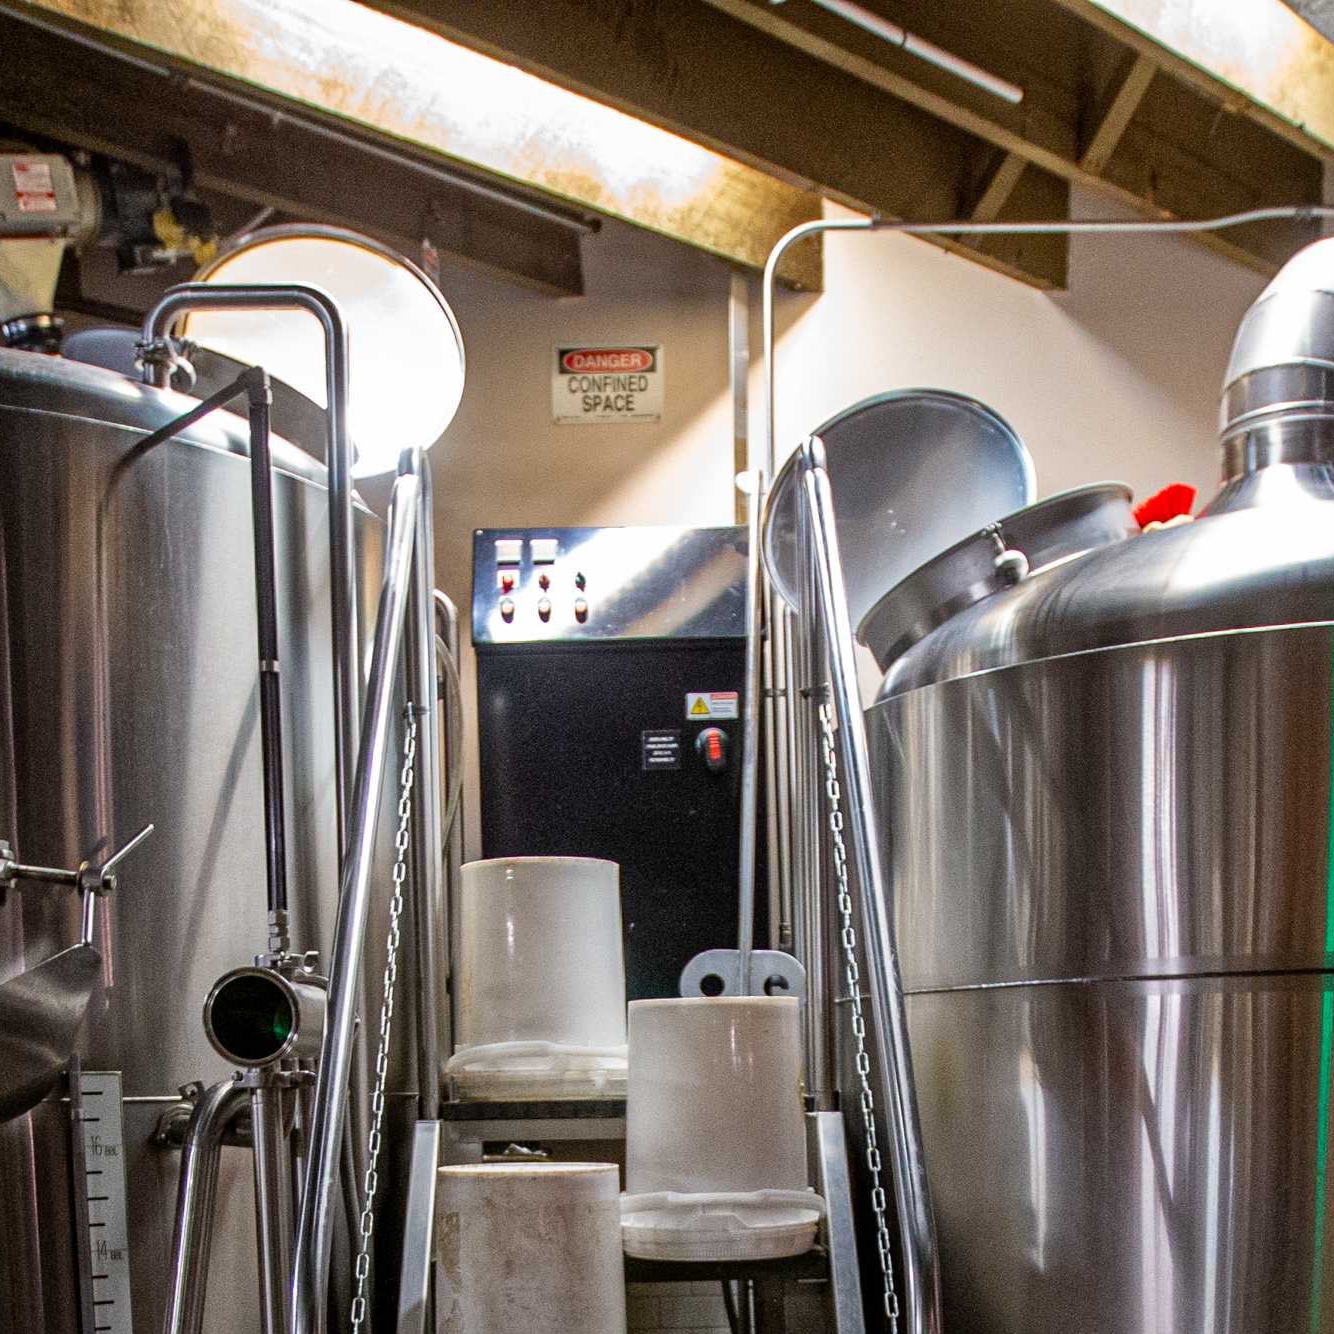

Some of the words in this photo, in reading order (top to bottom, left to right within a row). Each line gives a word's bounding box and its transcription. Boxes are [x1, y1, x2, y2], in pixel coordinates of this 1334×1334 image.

[573, 353, 642, 368] DANGER
[568, 374, 648, 393] CONFINED
[583, 394, 635, 412] SPACE
[91, 1135, 103, 1156] 16
[96, 1240, 108, 1261] 14
